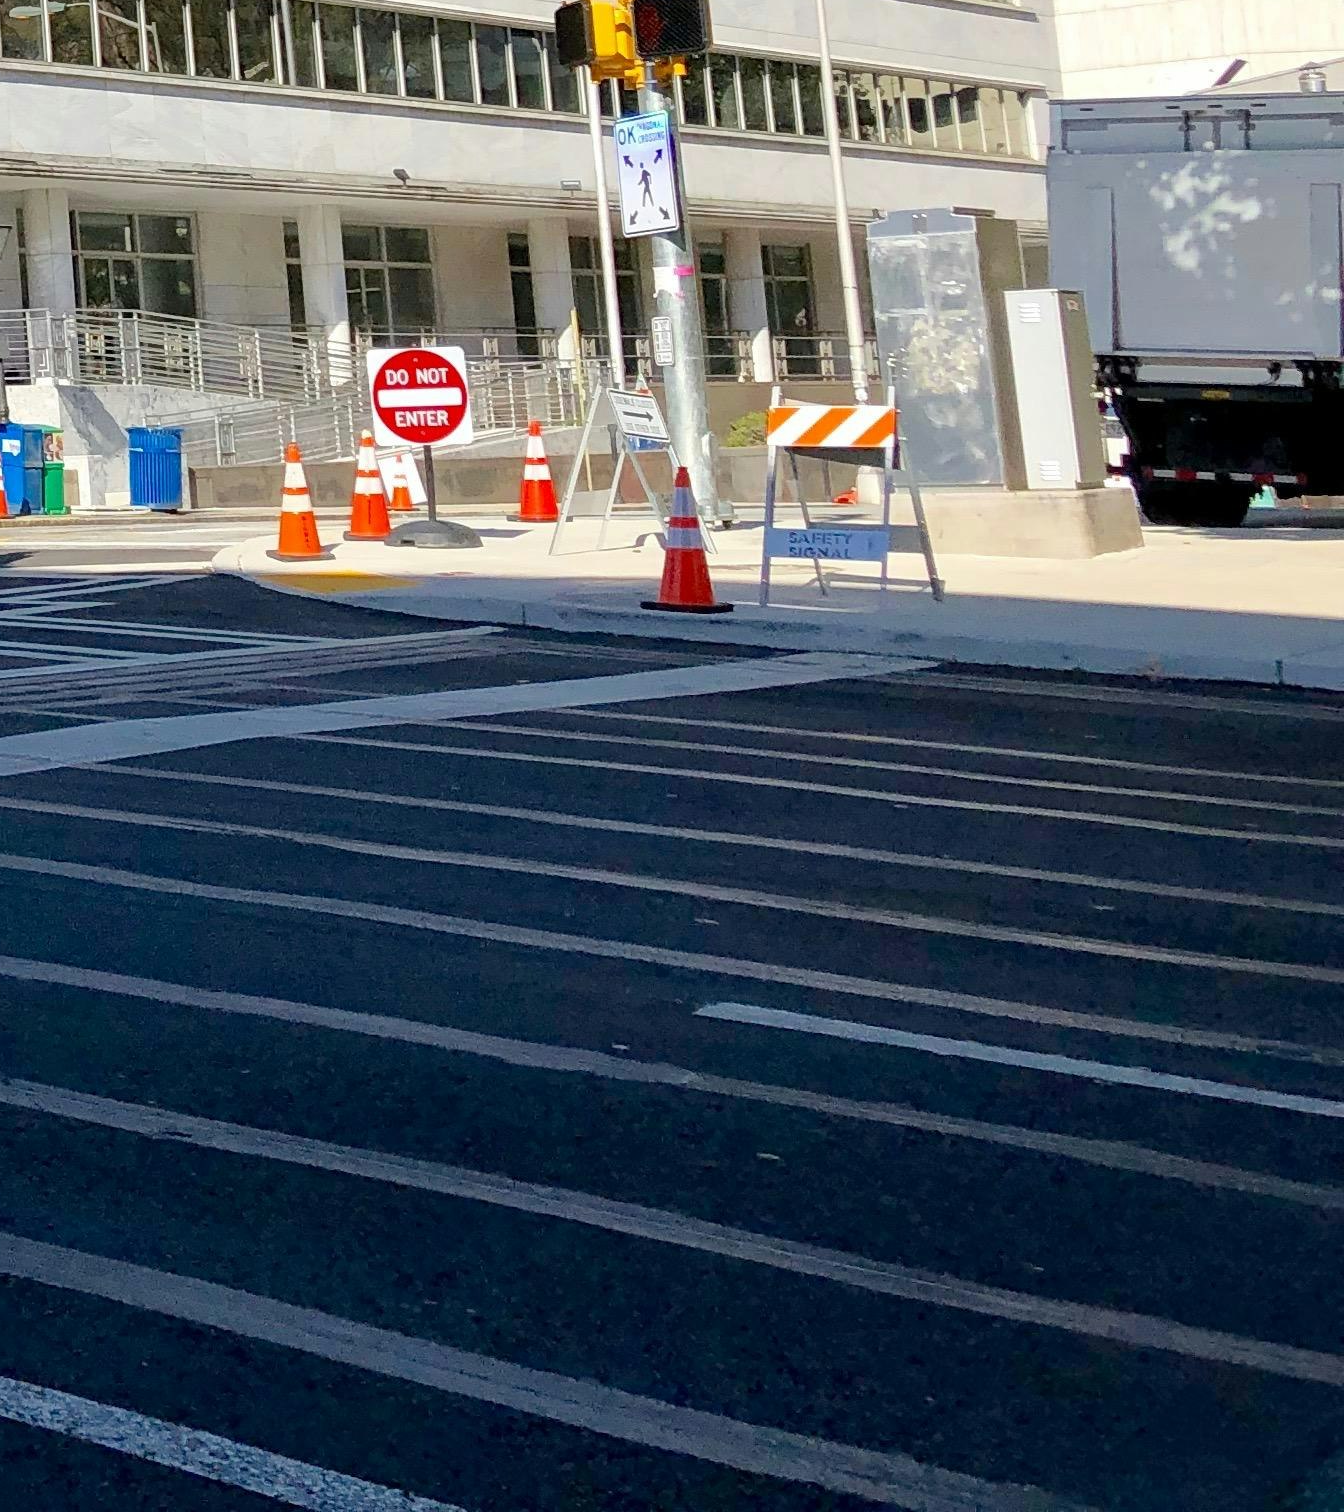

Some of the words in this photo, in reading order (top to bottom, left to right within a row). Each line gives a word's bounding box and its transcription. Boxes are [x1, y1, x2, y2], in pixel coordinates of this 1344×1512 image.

[618, 126, 636, 145] OK
[385, 369, 409, 385] DO
[415, 368, 448, 384] NOT
[395, 410, 450, 427] ENTER
[789, 531, 853, 546] SAFETY
[788, 547, 852, 559] SIGNAL
